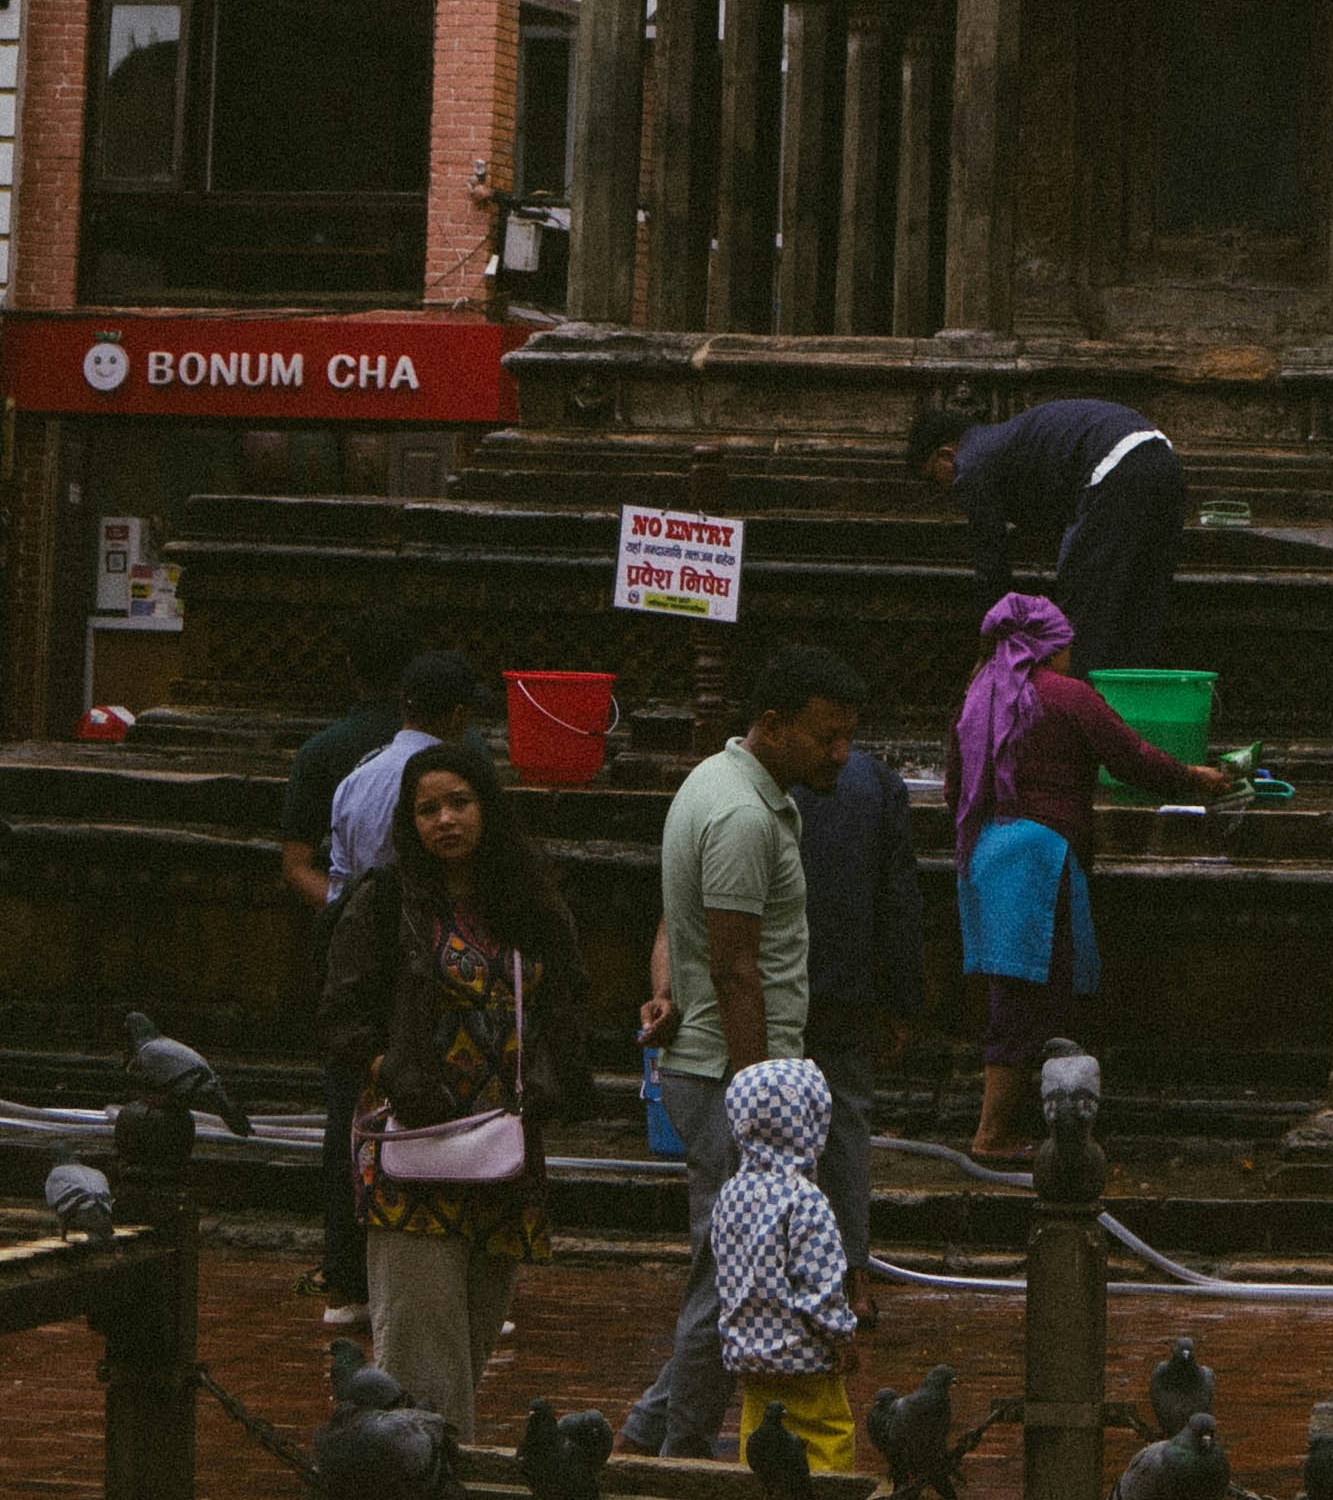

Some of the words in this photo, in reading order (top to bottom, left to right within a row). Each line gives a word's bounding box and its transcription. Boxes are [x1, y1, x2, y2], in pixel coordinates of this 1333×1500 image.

[147, 351, 304, 387] BONUM
[327, 354, 420, 389] CHA
[631, 514, 662, 538] NO
[665, 518, 735, 547] ENTRY
[626, 560, 674, 591] प्रवेश
[679, 564, 732, 598] निषेध
